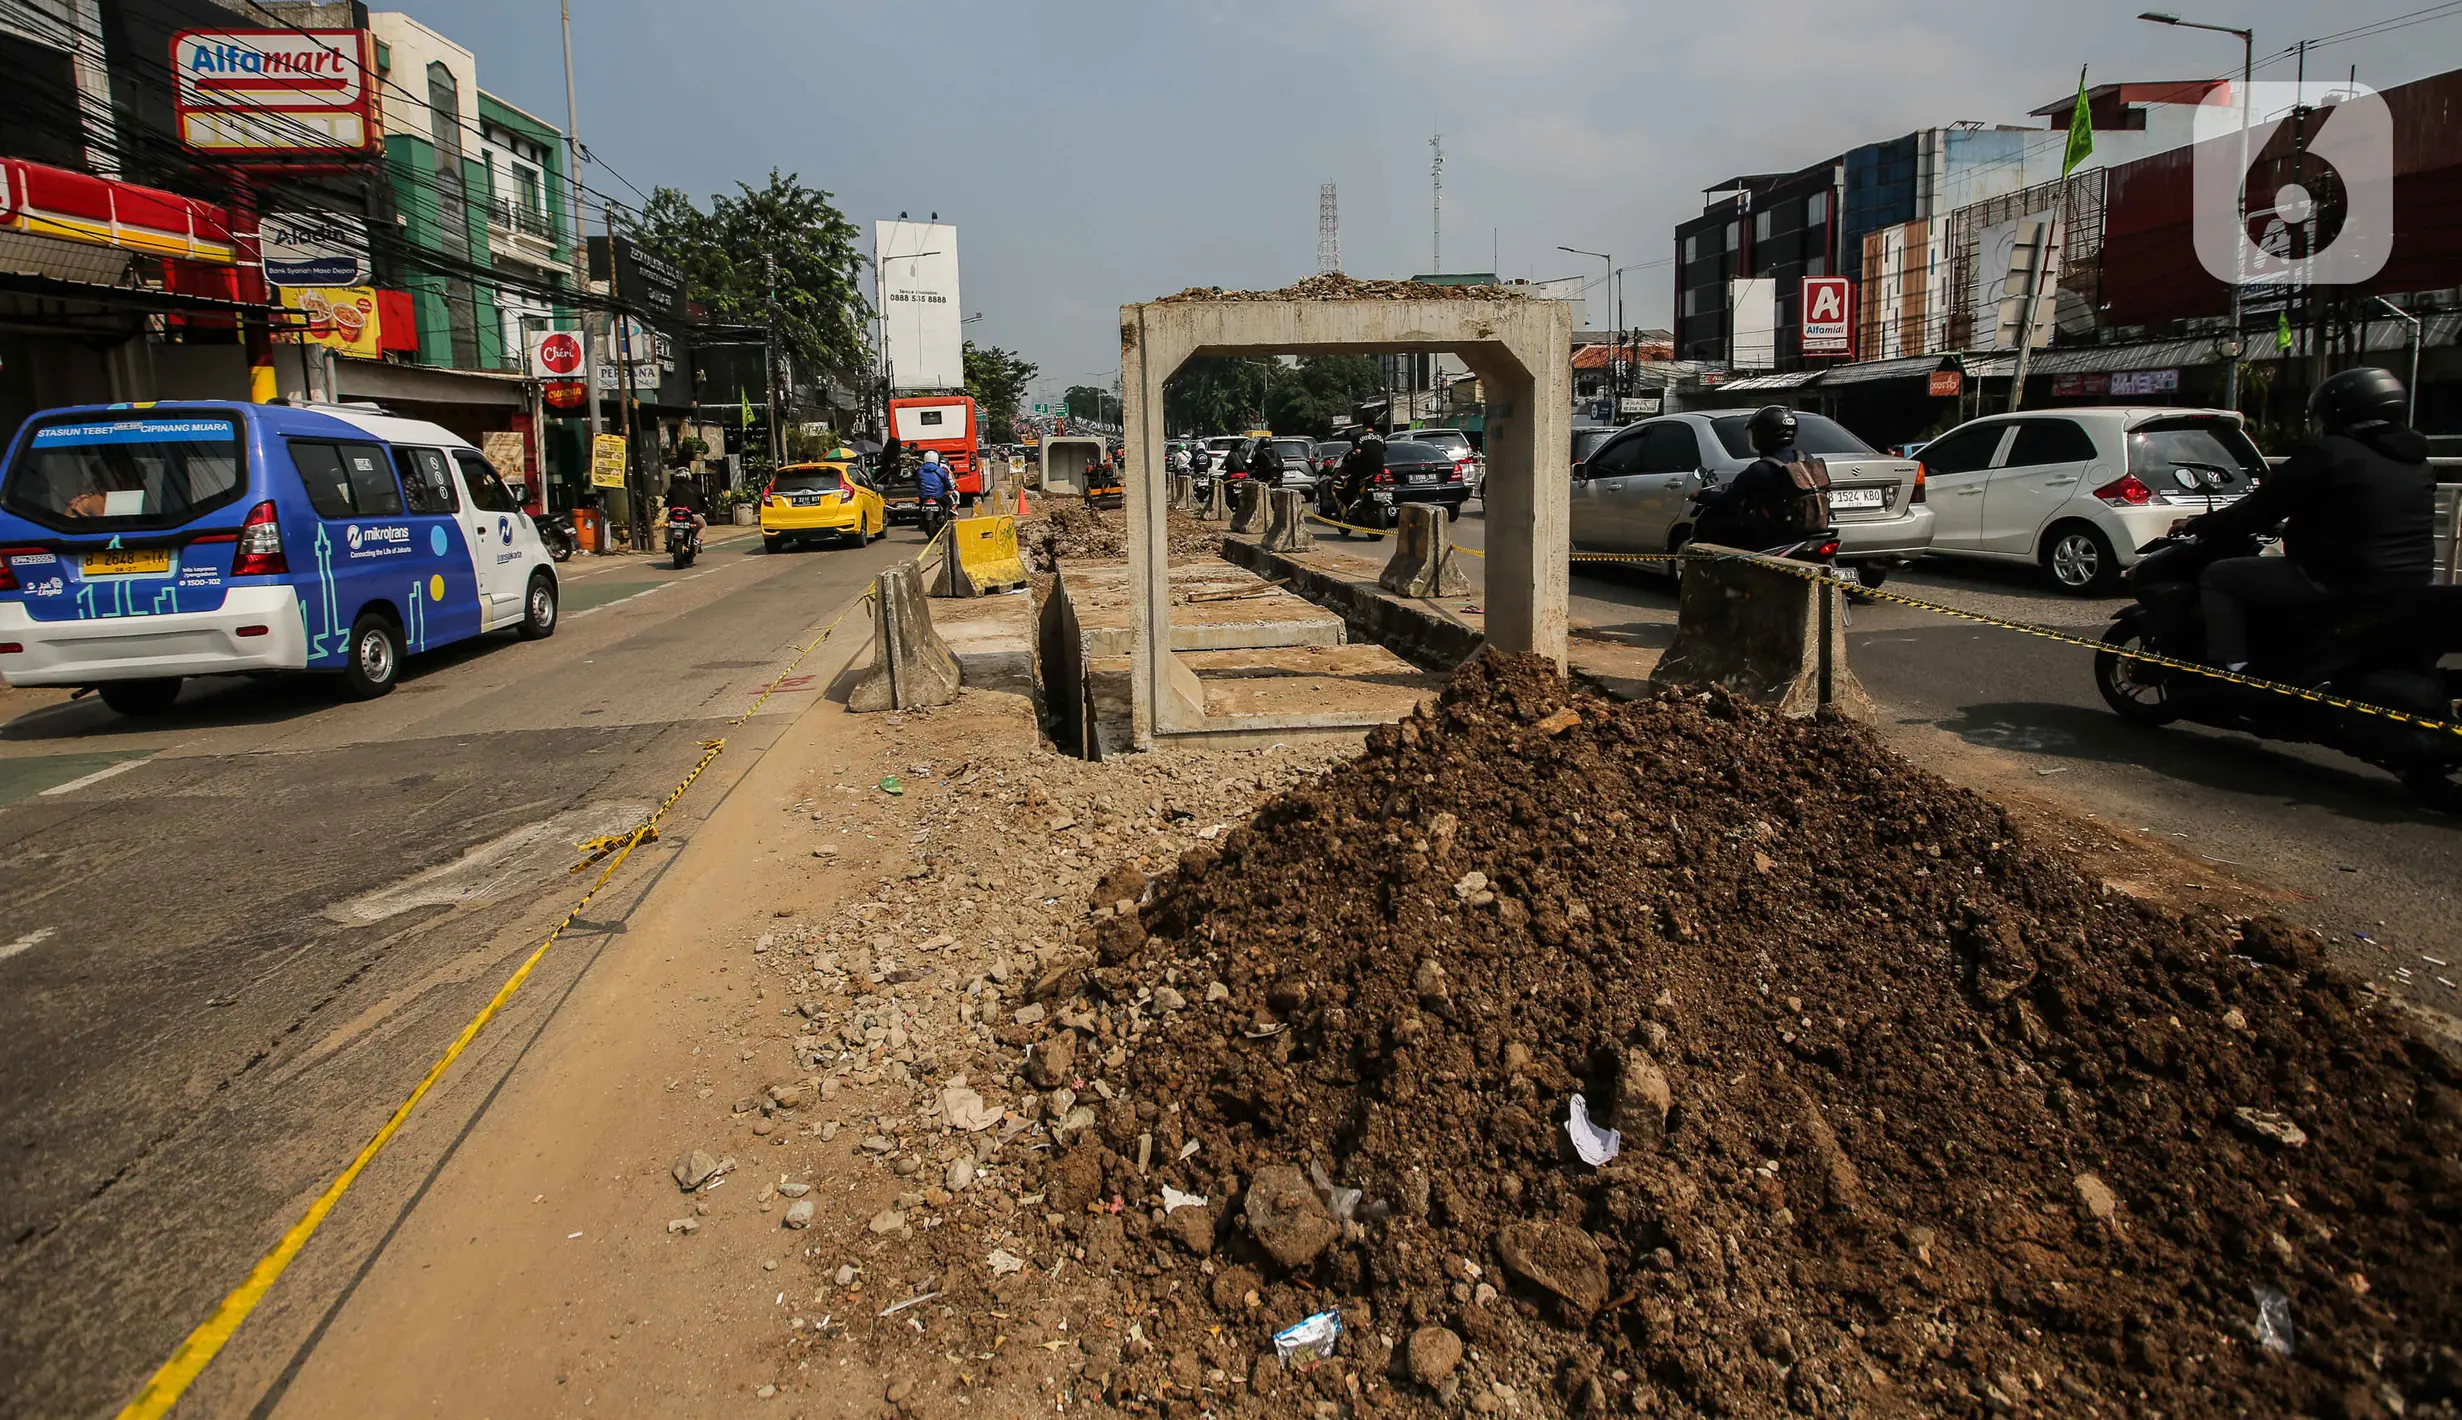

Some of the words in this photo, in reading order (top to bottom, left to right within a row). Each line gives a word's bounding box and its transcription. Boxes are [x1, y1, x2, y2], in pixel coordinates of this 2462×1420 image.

[192, 44, 345, 73] Alfamart
[287, 267, 312, 275] Syariah
[332, 267, 356, 275] Depan
[890, 294, 909, 302] 0888
[927, 296, 947, 304] 8888
[1806, 326, 1844, 334] Alfamidi
[543, 345, 575, 362] Chéri
[548, 387, 582, 399] CHACHA
[37, 428, 81, 438] STASIUN
[82, 426, 116, 436] TEBET
[140, 424, 190, 434] CIPINANG
[191, 423, 229, 432] MUARA
[1837, 491, 1859, 503] 1524
[364, 526, 409, 542] mikrotrans
[105, 551, 135, 566] 2648
[152, 550, 166, 564] TK
[350, 551, 376, 559] Connecting
